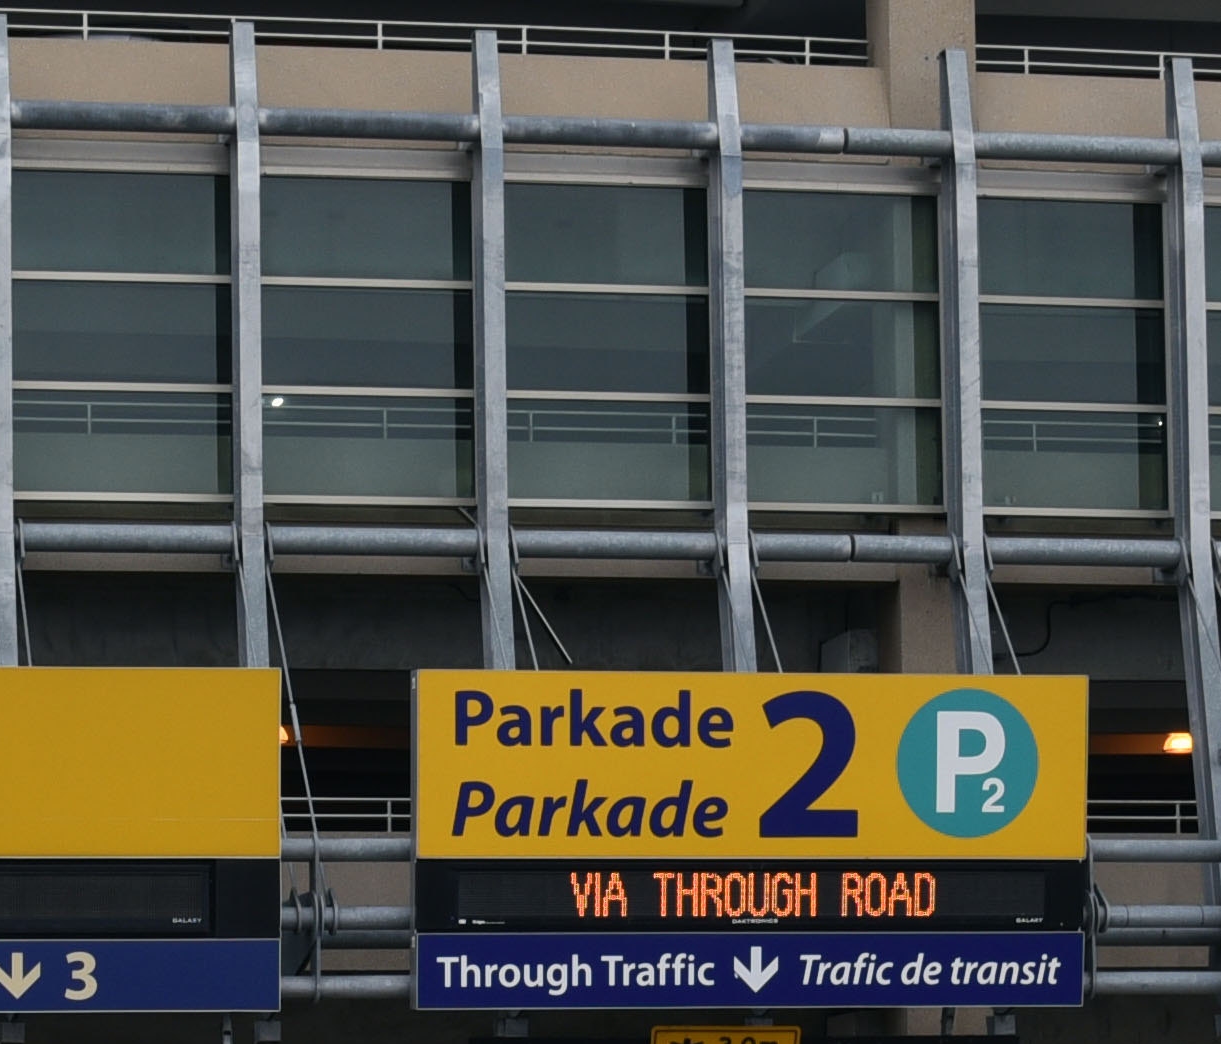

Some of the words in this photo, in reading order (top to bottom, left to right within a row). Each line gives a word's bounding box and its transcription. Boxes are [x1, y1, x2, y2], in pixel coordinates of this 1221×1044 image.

[455, 689, 734, 748] Parkade
[759, 691, 859, 838] 2
[451, 779, 729, 838] Parkade
[570, 872, 628, 918] VIA
[653, 872, 817, 918] THROUGH
[841, 872, 936, 917] ROAD
[64, 951, 98, 1001] 3
[436, 954, 592, 996] Through
[601, 952, 715, 987] Traffic
[799, 952, 894, 986] Trafic
[901, 953, 942, 986] de
[951, 953, 1062, 986] transit
